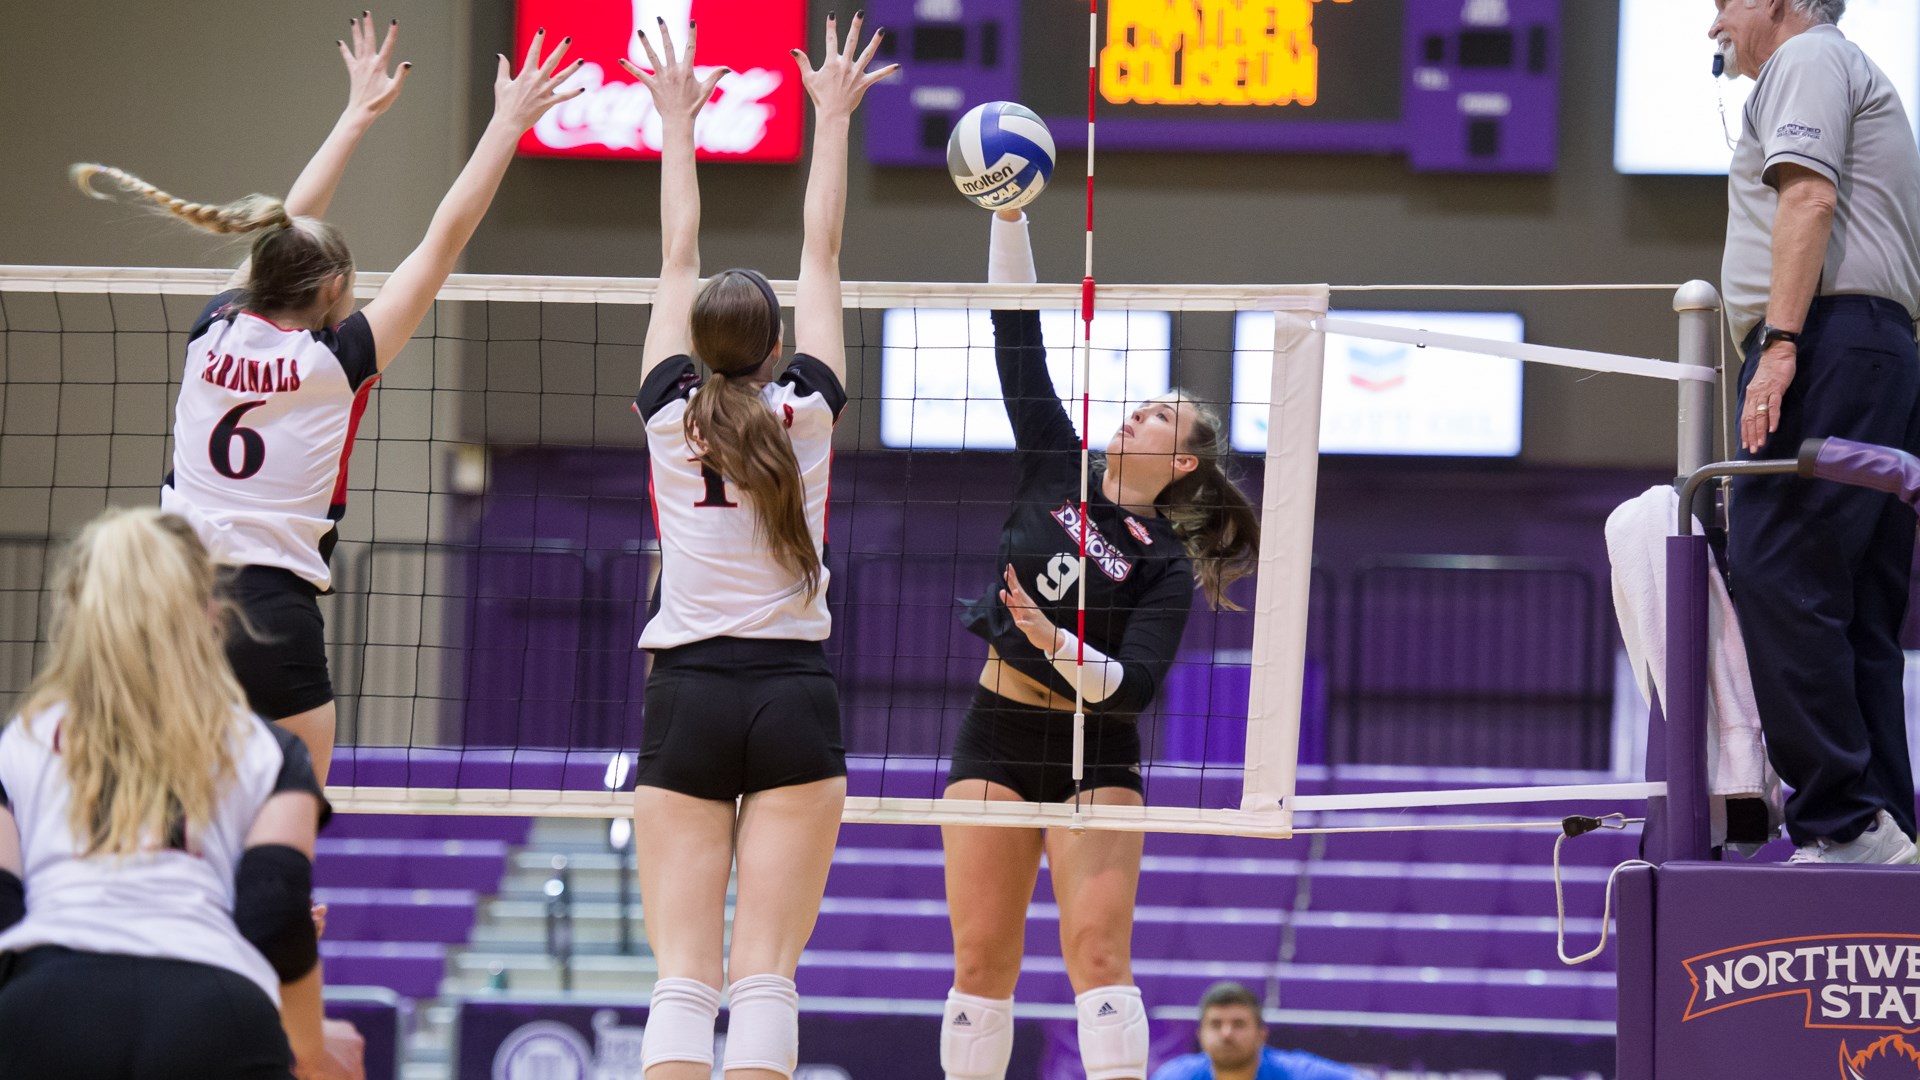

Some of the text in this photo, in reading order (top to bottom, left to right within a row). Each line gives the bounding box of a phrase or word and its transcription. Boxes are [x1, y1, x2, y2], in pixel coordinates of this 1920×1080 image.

[962, 165, 1014, 193] molten
[976, 181, 1022, 207] NCAA
[208, 400, 267, 480] 6
[1056, 506, 1129, 580] DEMONS
[1036, 552, 1081, 602] 9
